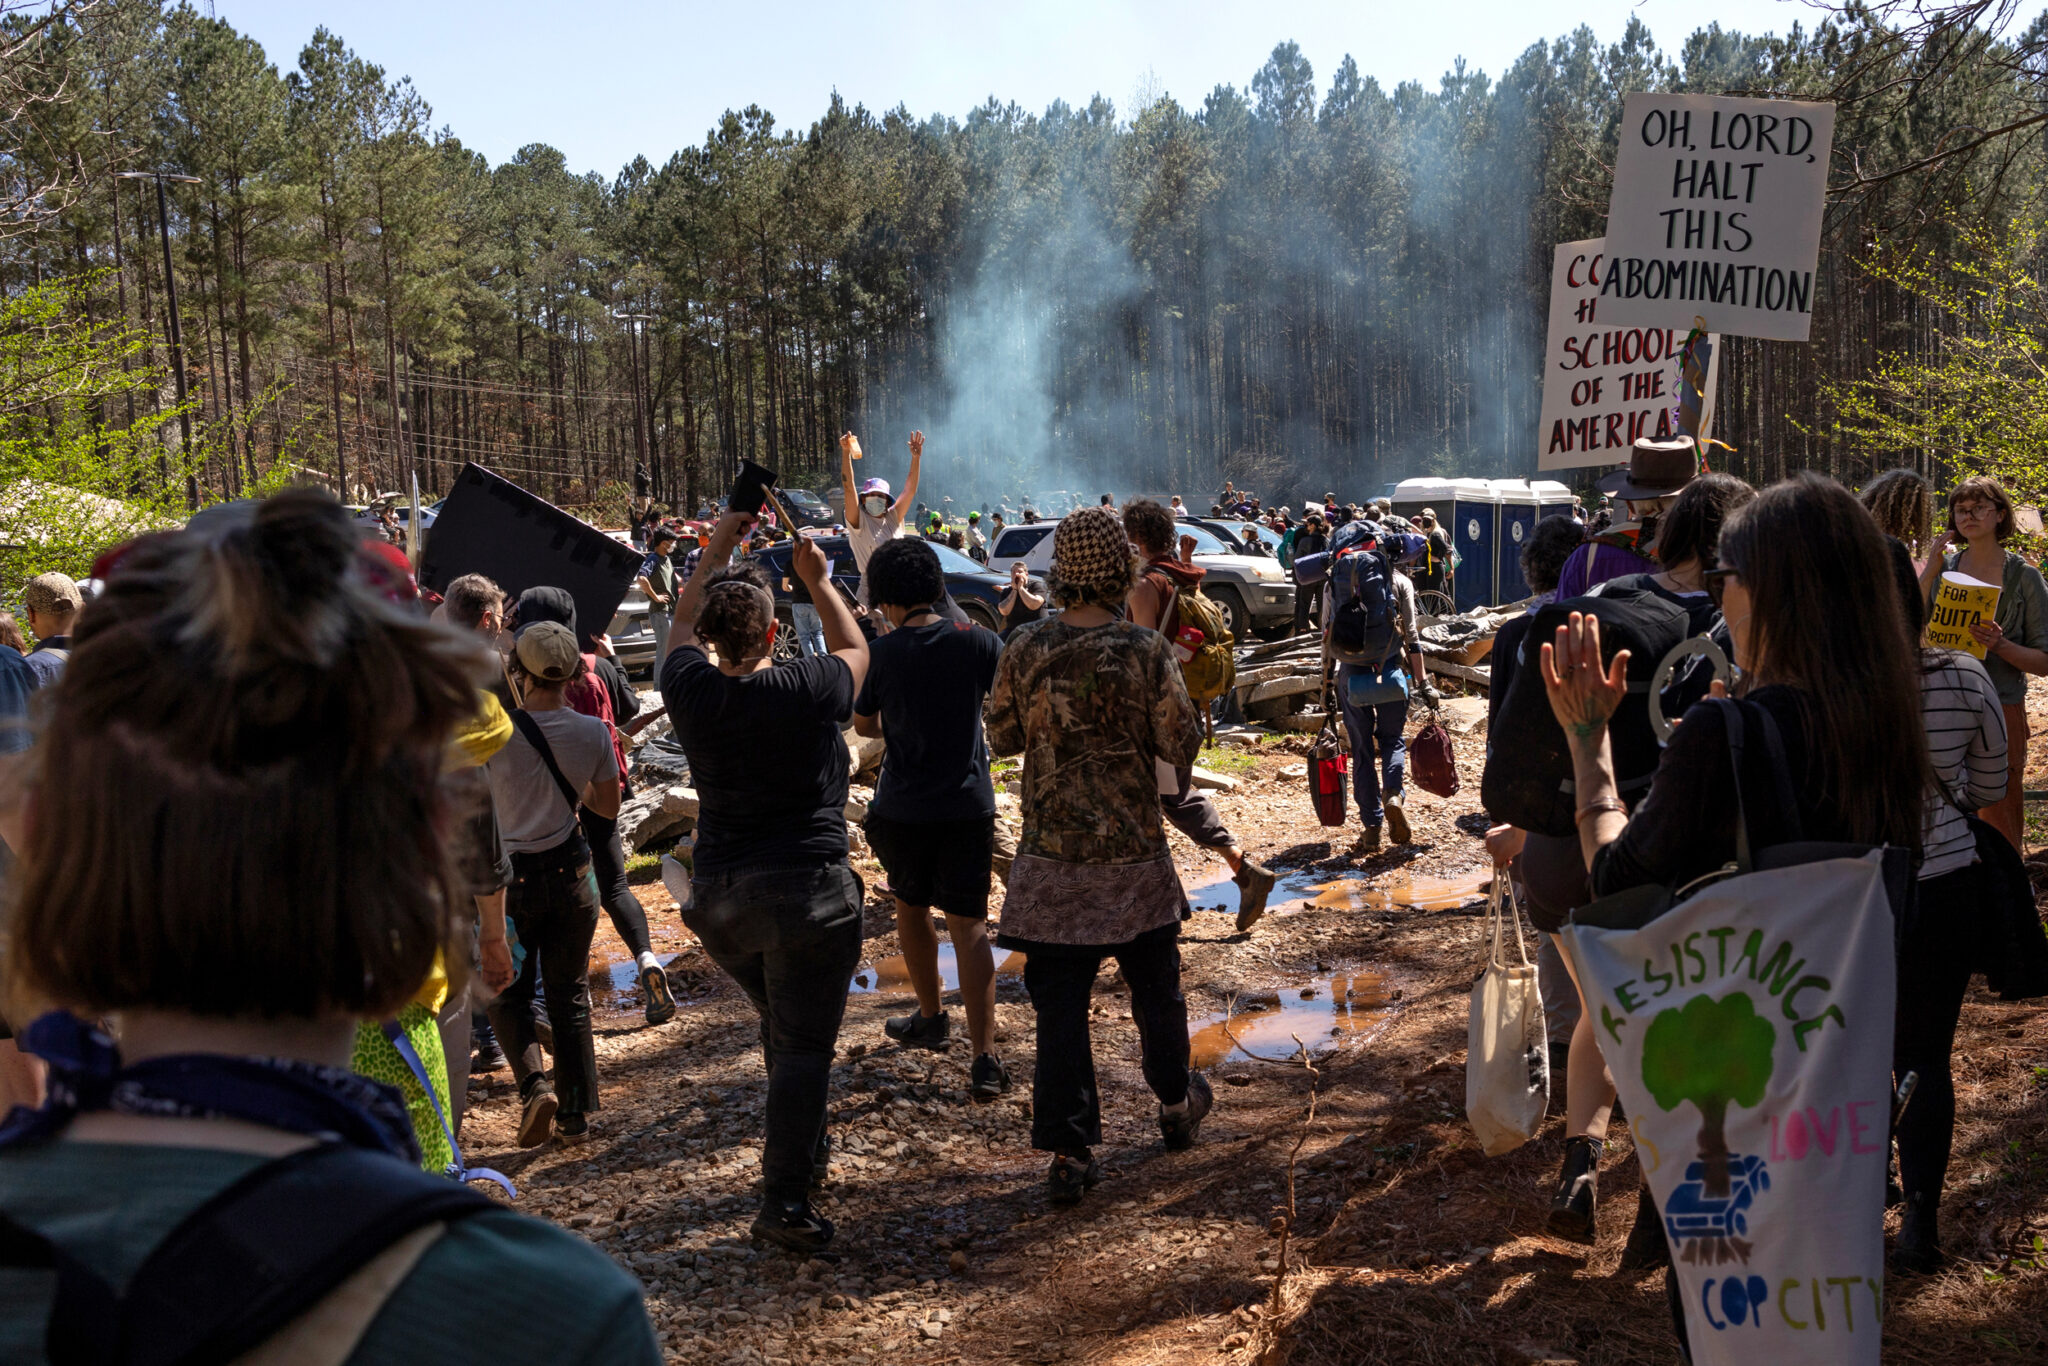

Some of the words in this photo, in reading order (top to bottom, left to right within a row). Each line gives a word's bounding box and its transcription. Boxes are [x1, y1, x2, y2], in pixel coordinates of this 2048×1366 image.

[1641, 109, 1697, 152] OH,
[1709, 110, 1816, 164] LORD,
[1672, 159, 1765, 204] HALT
[1659, 207, 1754, 253] THIS
[1559, 327, 1683, 371] SCHOOL
[1570, 376, 1604, 407] OF
[1618, 368, 1666, 402] THE
[1943, 585, 1969, 603] FOR
[1600, 926, 1846, 1053] RESISTANCE
[1769, 1101, 1881, 1164] LOVE
[1703, 1275, 1768, 1331] COP
[1777, 1276, 1883, 1333] CITY
